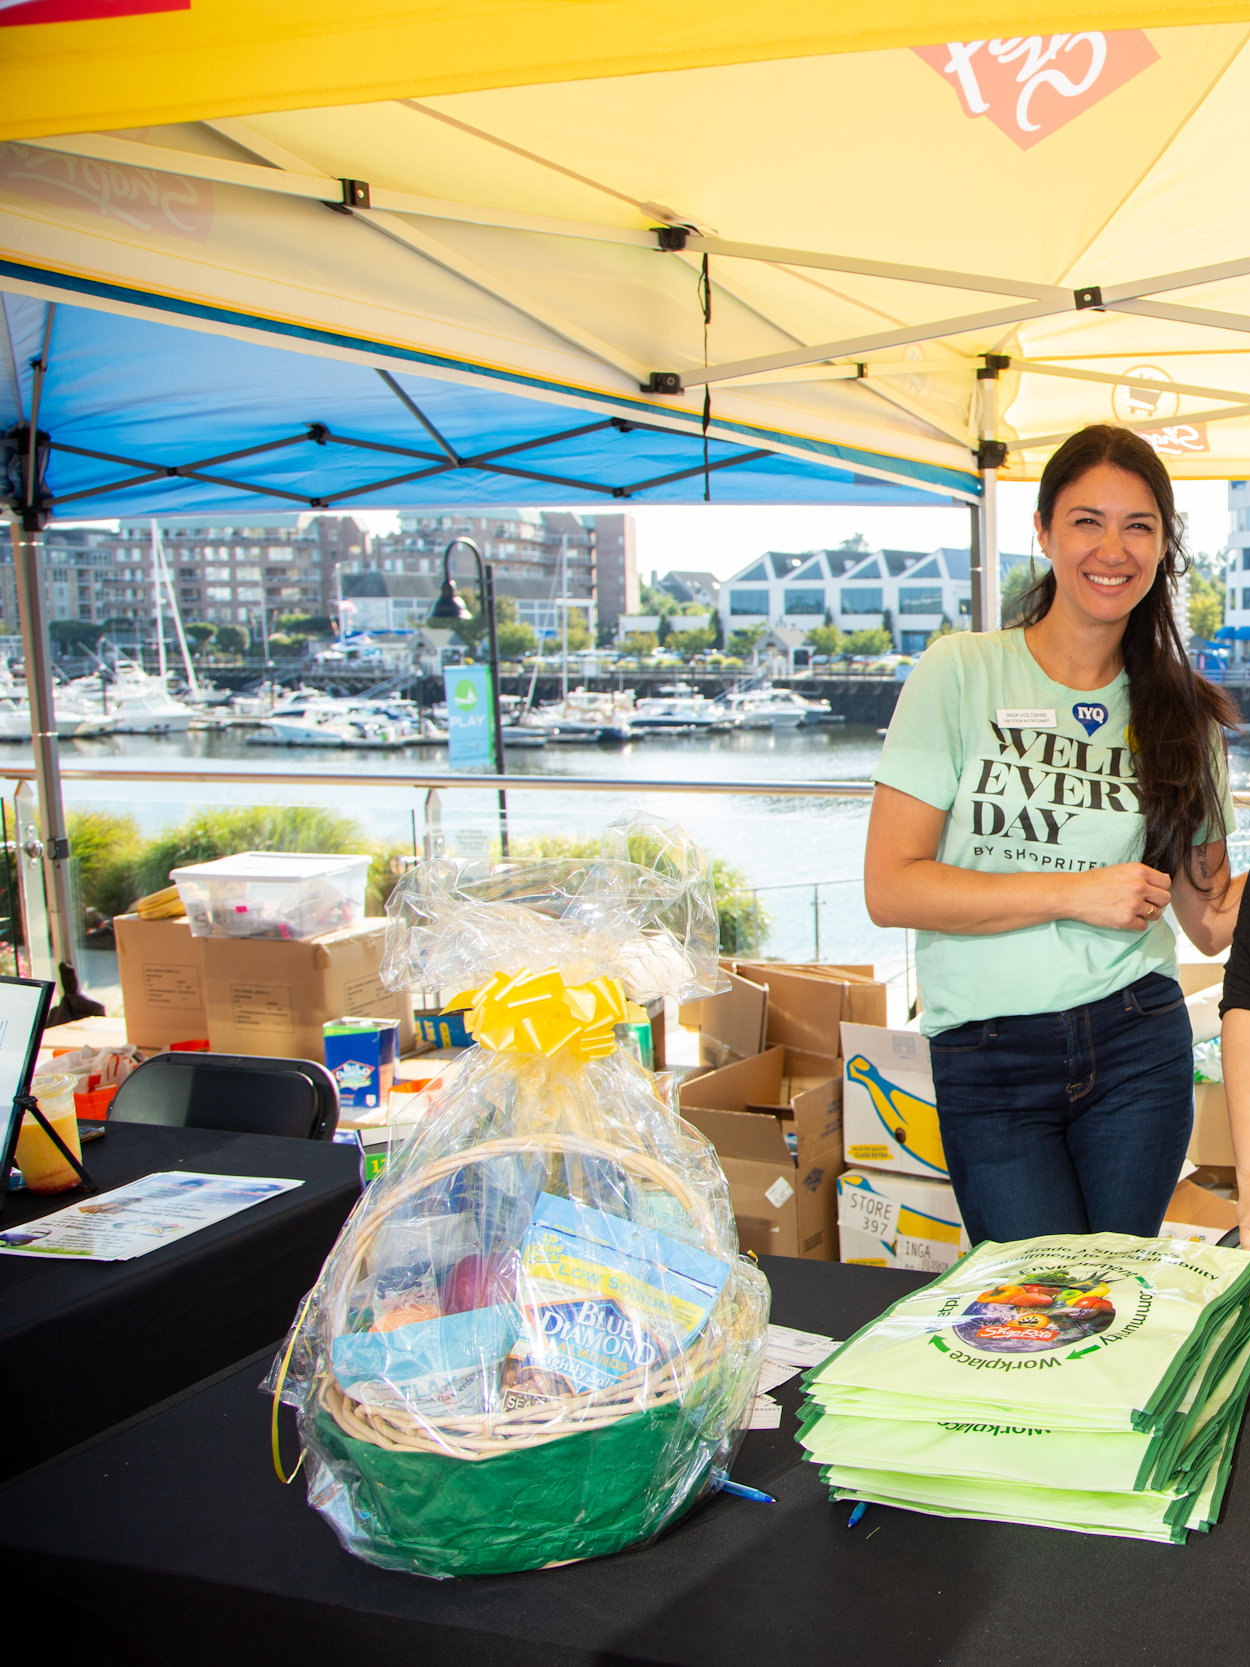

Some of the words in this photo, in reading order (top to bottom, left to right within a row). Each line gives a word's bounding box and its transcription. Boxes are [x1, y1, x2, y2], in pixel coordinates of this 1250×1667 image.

[449, 714, 485, 728] PLAY
[1077, 706, 1105, 724] IYQ
[989, 720, 1138, 778] WELL
[971, 800, 1080, 845] DAY
[974, 846, 994, 856] BY
[850, 1193, 893, 1220] STORE
[862, 1217, 888, 1235] 397
[905, 1241, 931, 1259] INGA
[1024, 1246, 1072, 1255] Grade
[558, 1263, 602, 1284] LOW
[607, 1276, 671, 1313] SODIUM
[979, 1326, 1054, 1340] ShopRite
[557, 1341, 629, 1373] ALMONDS
[949, 1349, 1062, 1372] Workplace
